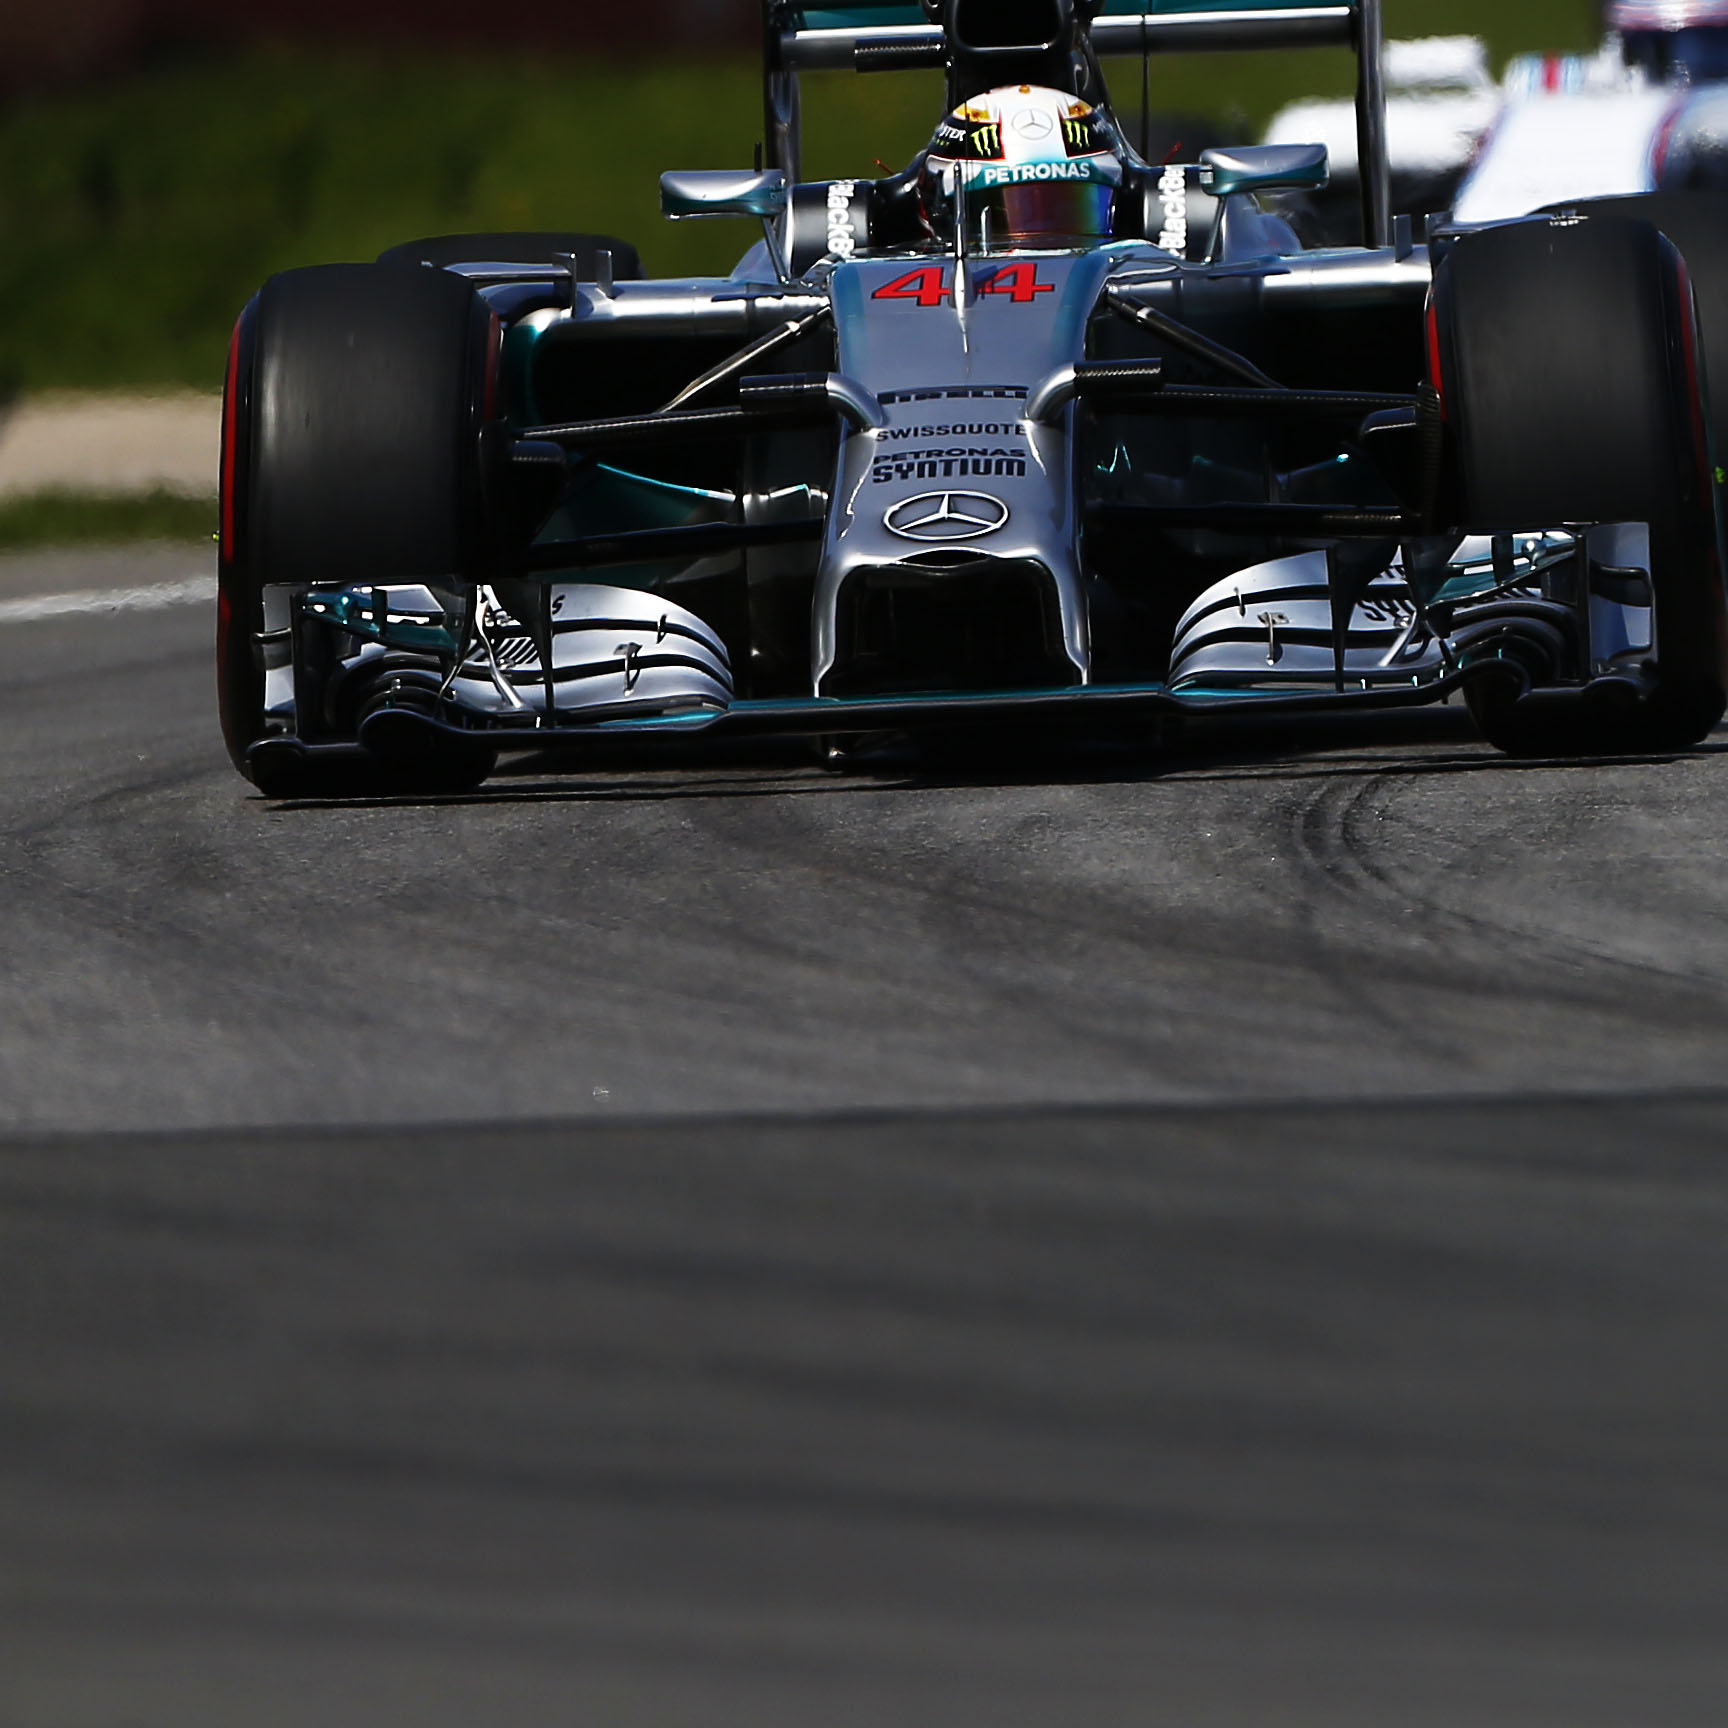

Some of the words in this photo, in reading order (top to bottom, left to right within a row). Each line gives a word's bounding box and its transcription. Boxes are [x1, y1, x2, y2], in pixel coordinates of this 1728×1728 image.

[984, 162, 1090, 186] PETRONAS
[871, 262, 1055, 307] 44
[876, 423, 1027, 442] SWISSQUOTE
[873, 448, 1026, 465] PETRONAS
[872, 458, 1026, 484] SYNTIUM
